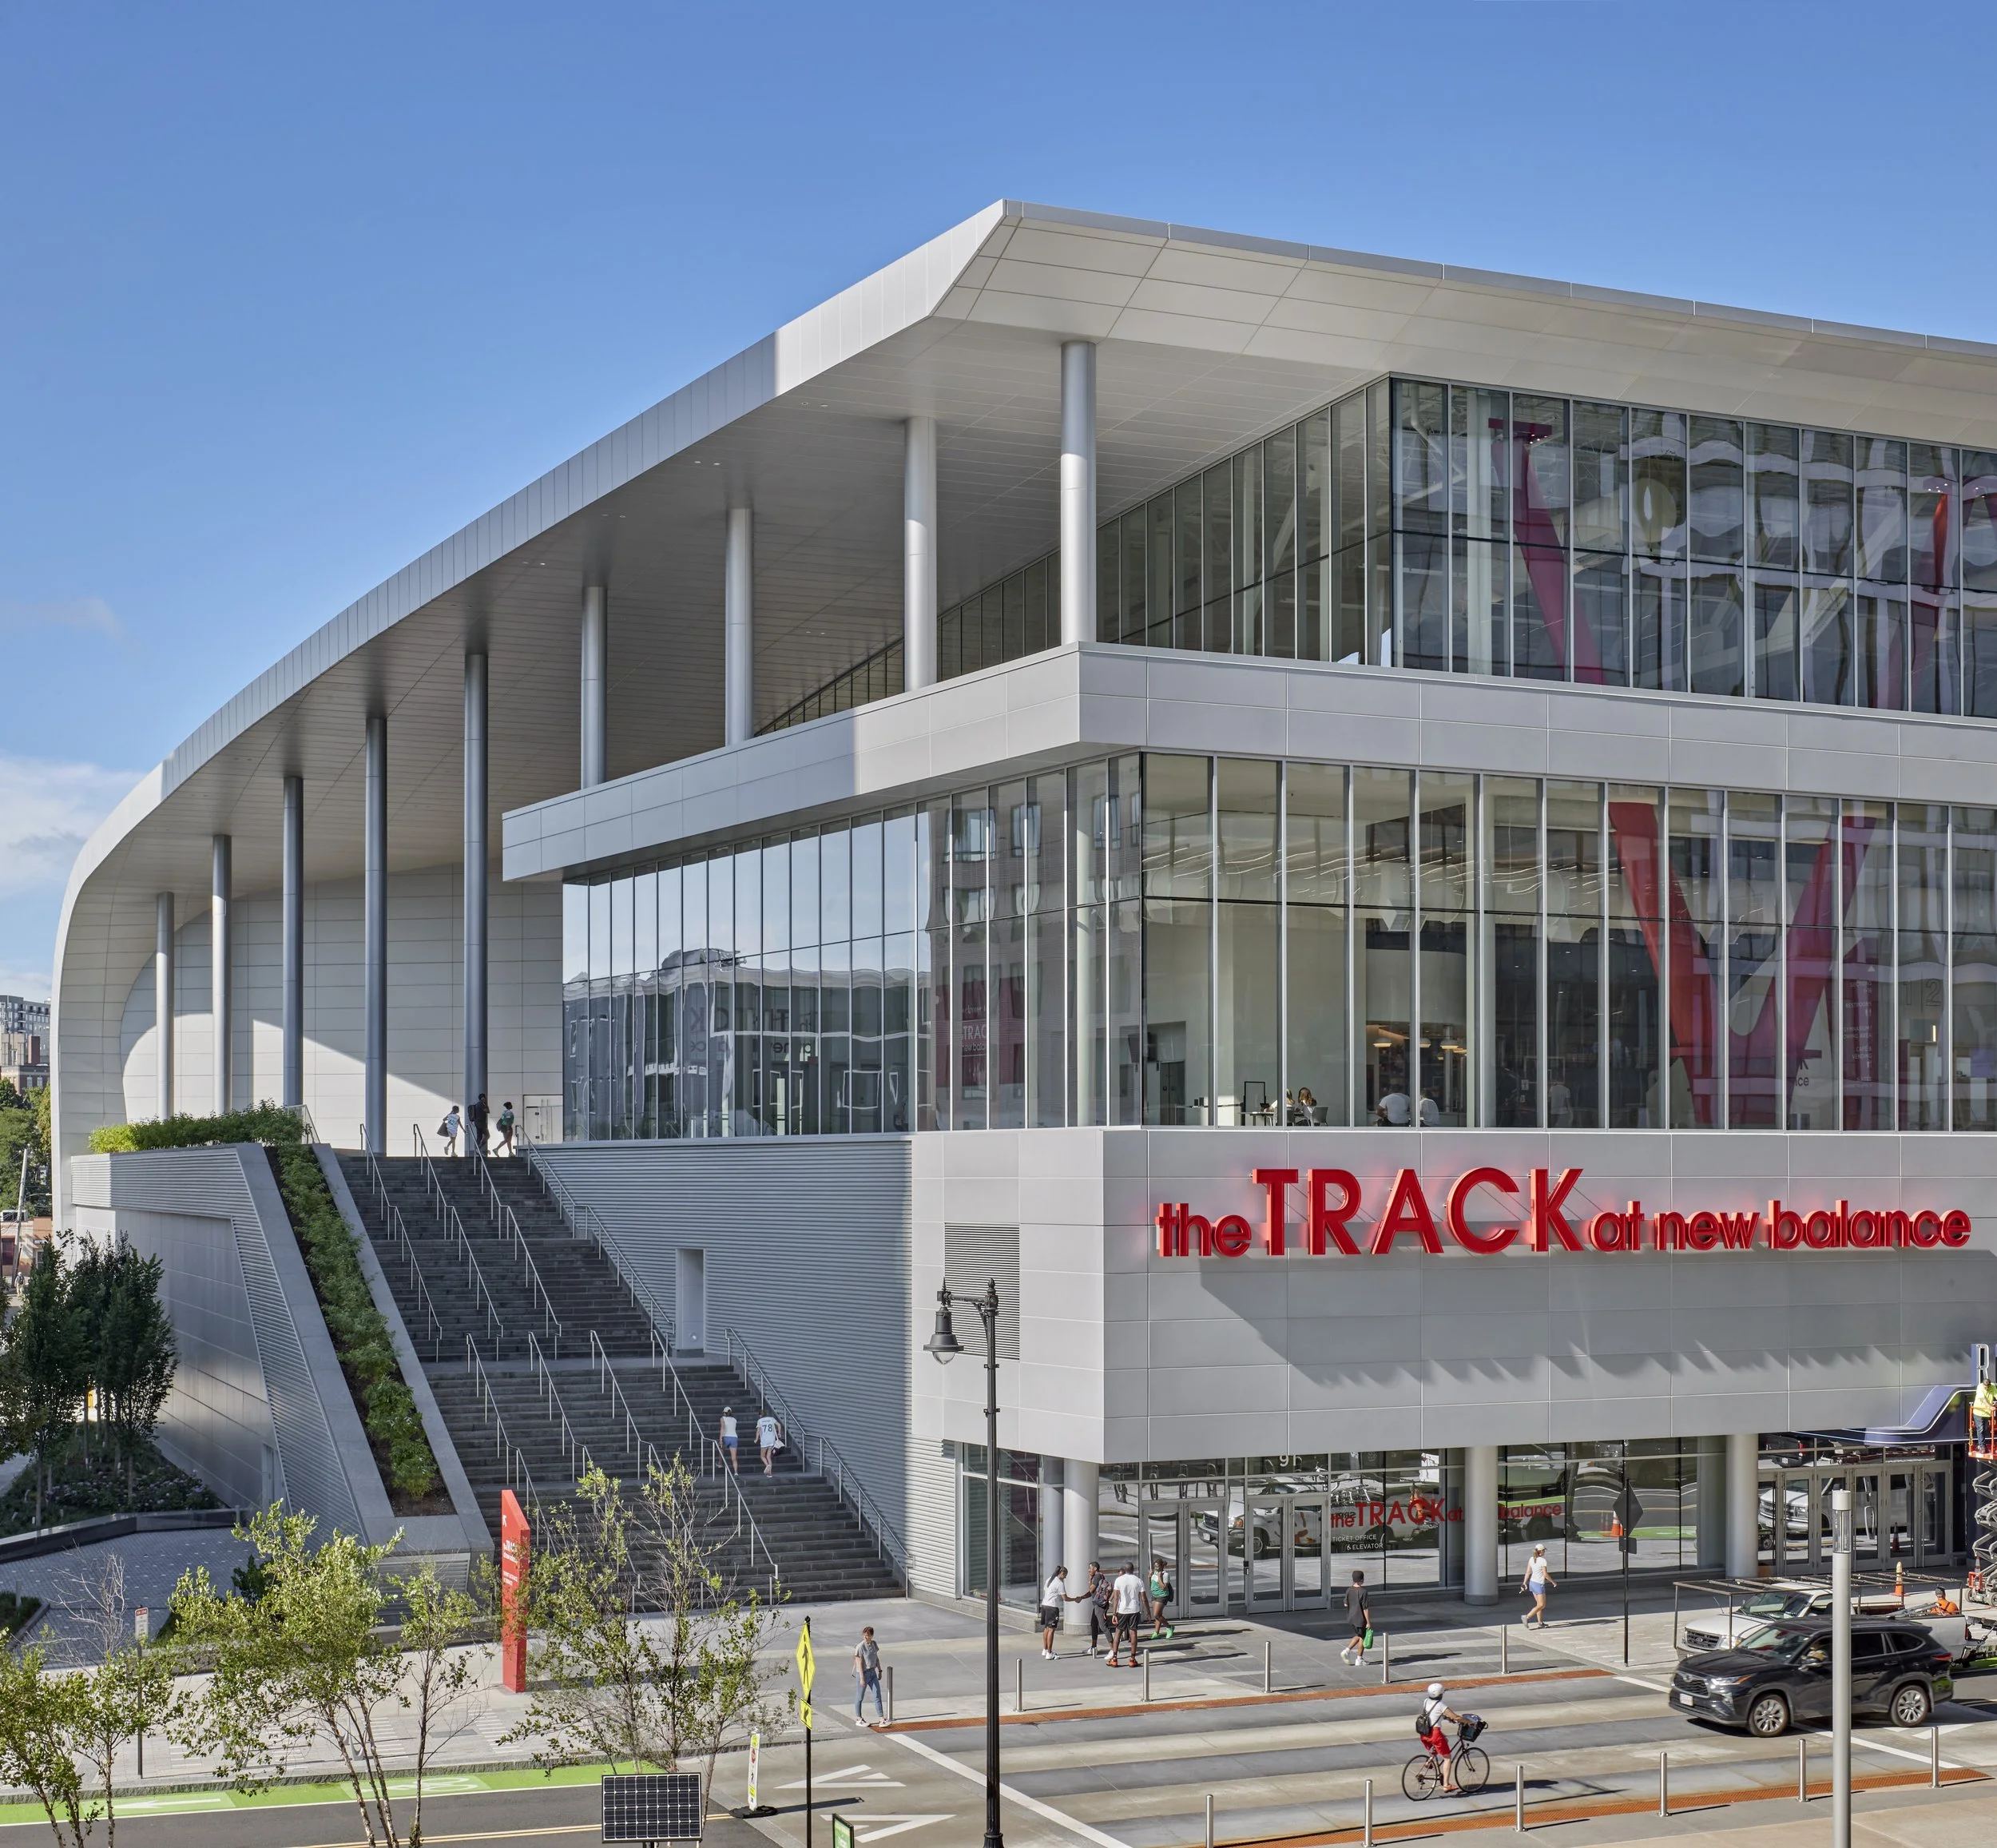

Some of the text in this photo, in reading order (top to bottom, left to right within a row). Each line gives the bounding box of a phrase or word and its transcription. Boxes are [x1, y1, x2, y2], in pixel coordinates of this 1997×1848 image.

[963, 1024, 987, 1039] TRAC
[1156, 1167, 1971, 1258] the TRACK at new balance
[1331, 1512, 1356, 1528] the
[1356, 1497, 1446, 1528] TRACK
[1447, 1507, 1463, 1522] at
[1499, 1502, 1562, 1520] balance
